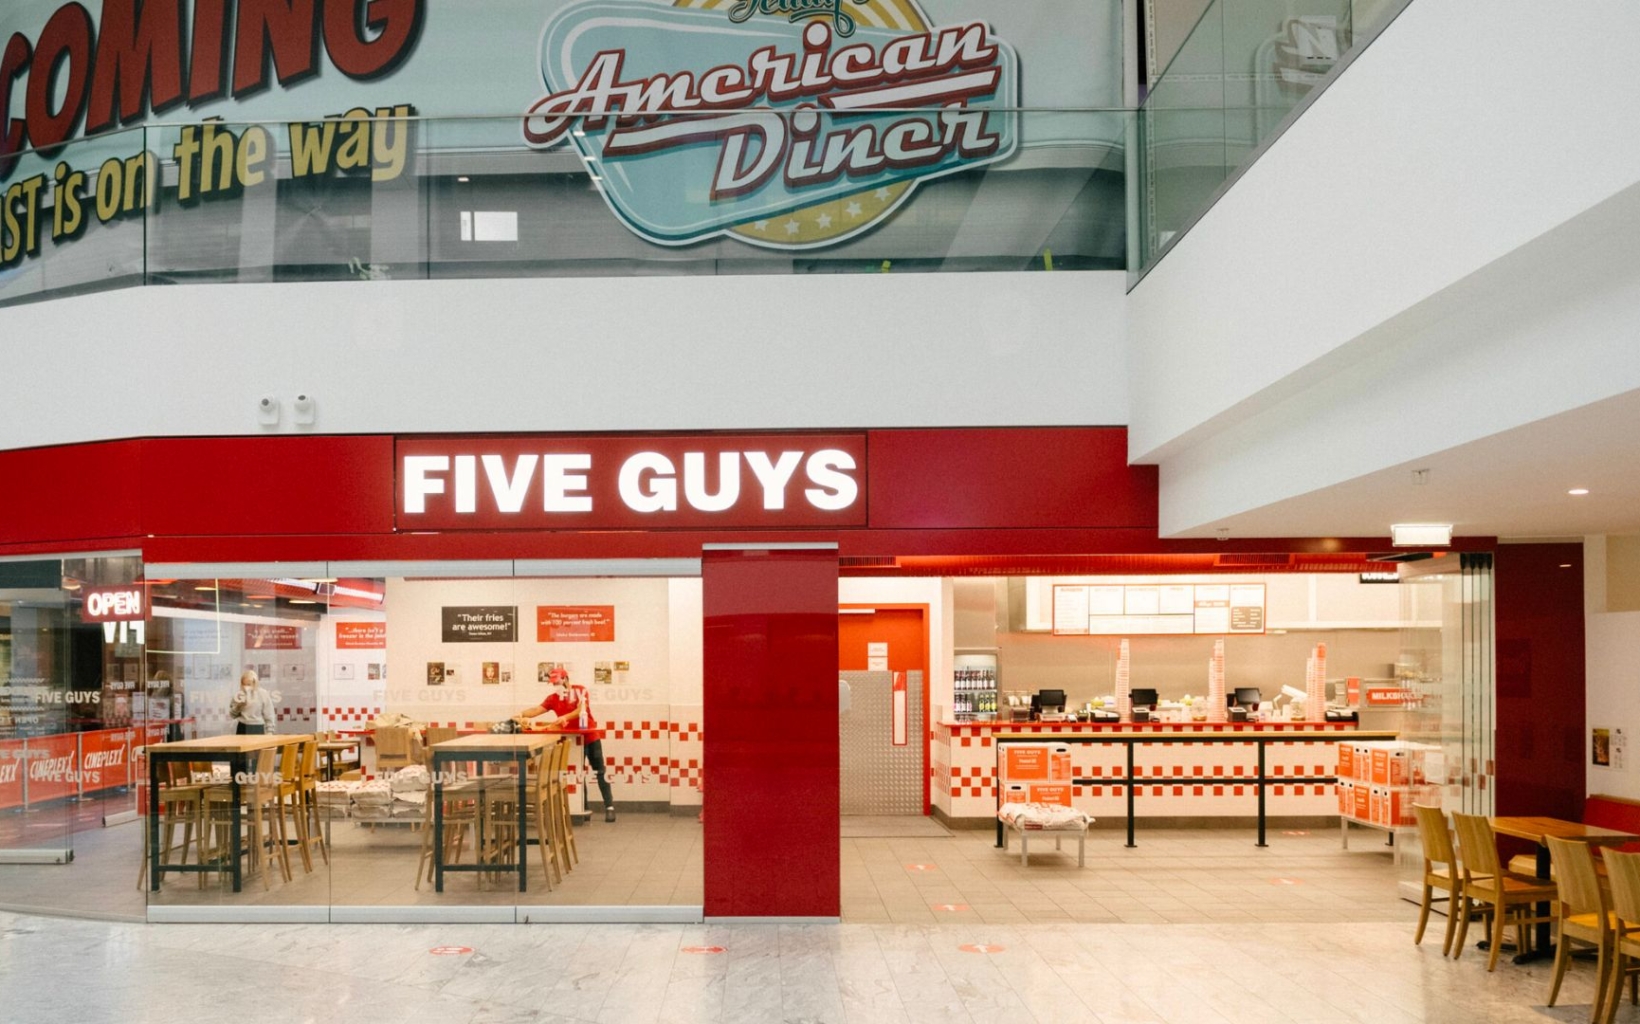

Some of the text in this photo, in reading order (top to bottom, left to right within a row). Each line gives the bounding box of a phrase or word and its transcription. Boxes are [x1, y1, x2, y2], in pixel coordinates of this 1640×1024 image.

[523, 20, 999, 147] American
[706, 98, 1000, 206] Diner
[51, 160, 84, 242] is
[95, 150, 157, 222] on
[173, 115, 270, 202] the
[289, 103, 415, 181] way
[403, 449, 859, 514] FIVE GUYS
[87, 591, 141, 616] OPEN
[451, 623, 466, 631] are
[485, 613, 504, 622] fries
[35, 691, 62, 704] FIVE
[65, 691, 101, 704] GUYS
[30, 750, 75, 779] CINEPLEXX
[84, 744, 126, 770] CINEPLEXX
[65, 770, 101, 784] GUYS
